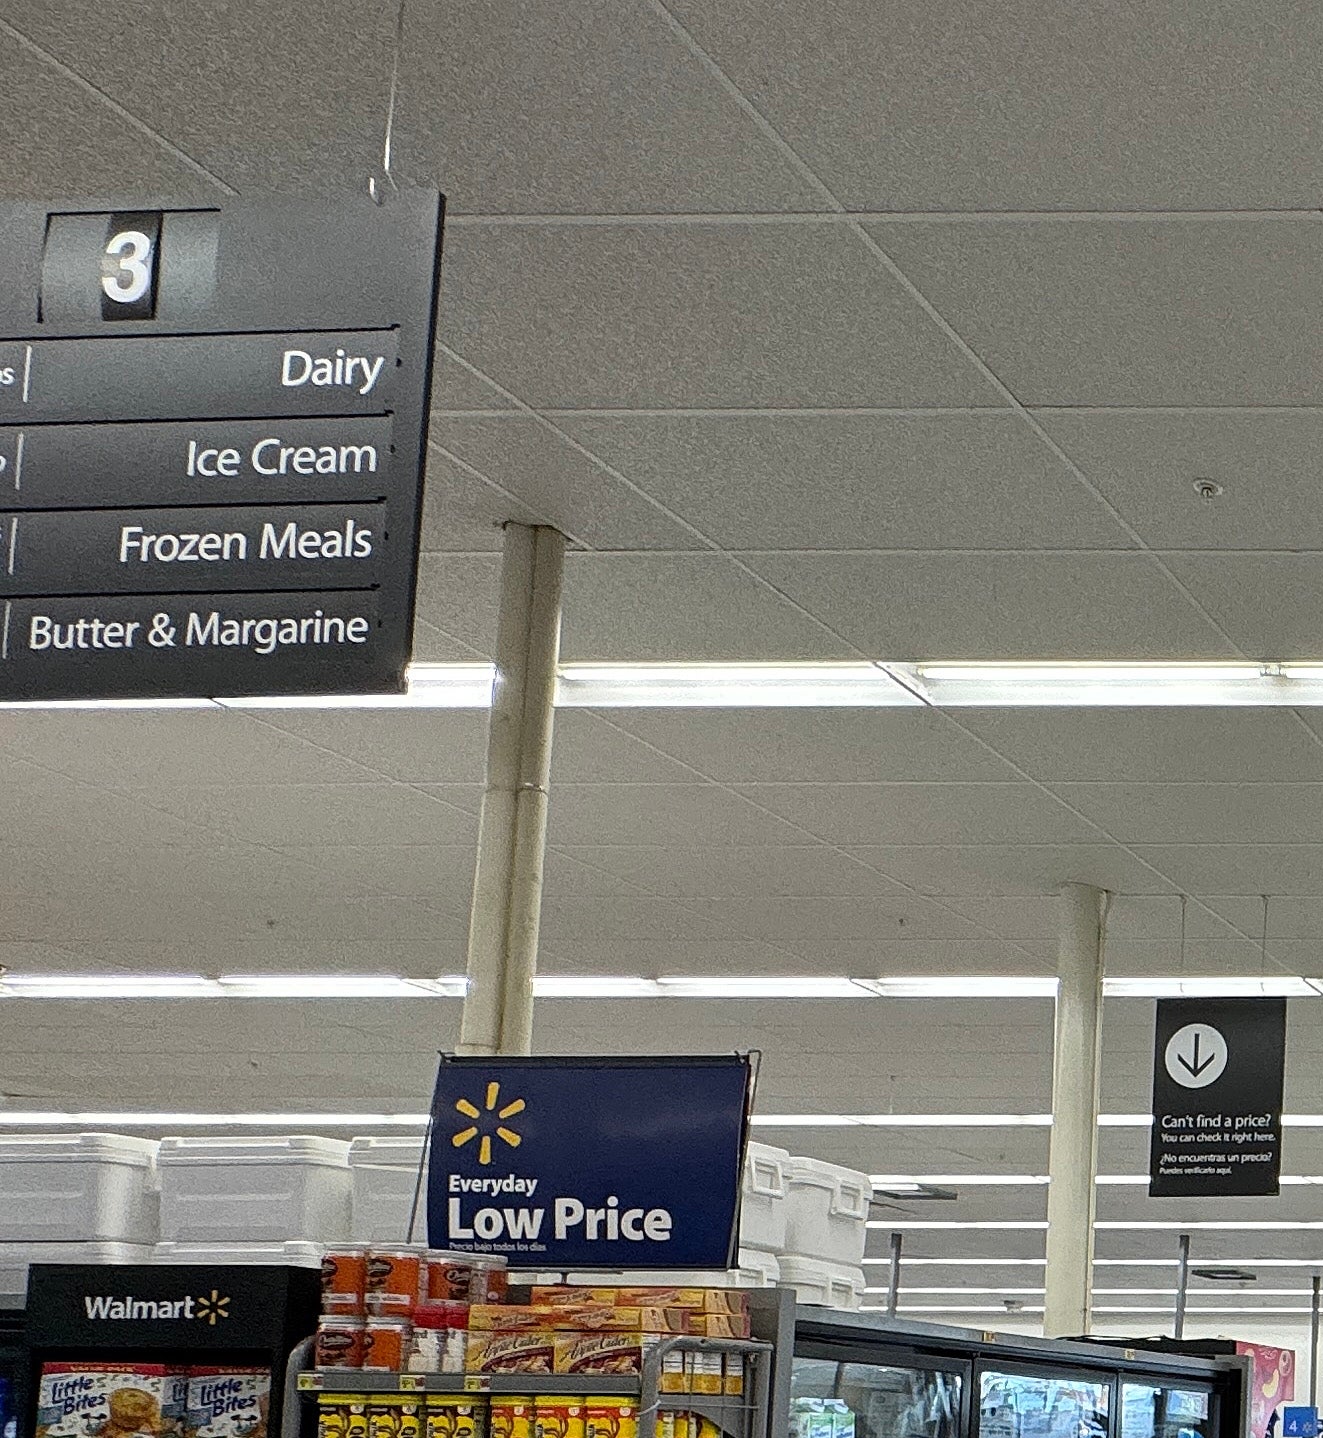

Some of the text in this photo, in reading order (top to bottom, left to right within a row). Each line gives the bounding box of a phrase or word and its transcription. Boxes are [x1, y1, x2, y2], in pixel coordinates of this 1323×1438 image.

[101, 232, 152, 303] 3
[280, 350, 384, 394] Dairy
[187, 439, 377, 477] Ice Cream
[119, 513, 372, 562] Frozen Meals
[29, 609, 369, 653] Butter & Margarine
[1162, 1114, 1272, 1130] Can't find a price?
[1161, 1133, 1275, 1143] You can check it right here.
[1160, 1152, 1272, 1165] ¿No encuentras un precio?
[449, 1174, 538, 1196] Everyday
[449, 1196, 672, 1241] Low Price
[85, 1296, 195, 1319] Walmart
[51, 1376, 94, 1405] Little
[200, 1378, 243, 1406] Little
[63, 1393, 108, 1415] Bites
[212, 1395, 257, 1417] Bites
[1288, 1421, 1297, 1432] 4
